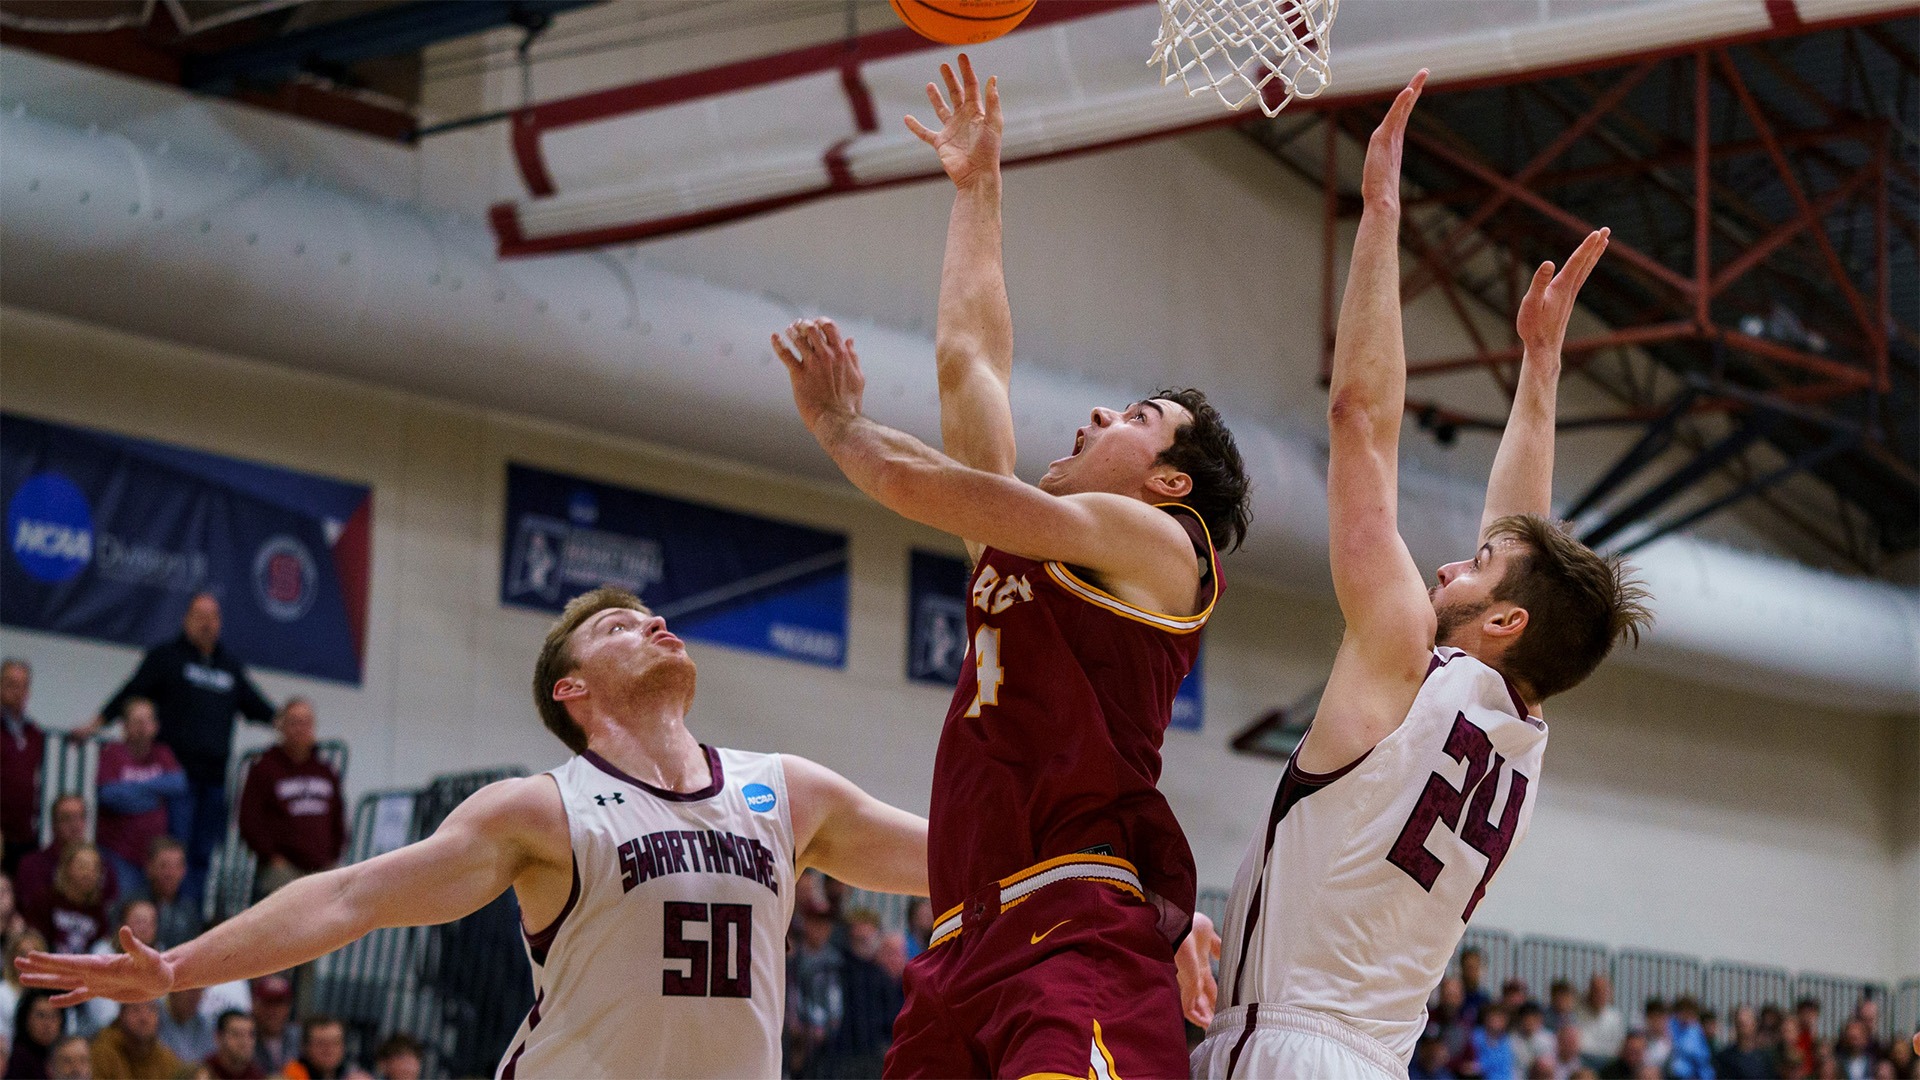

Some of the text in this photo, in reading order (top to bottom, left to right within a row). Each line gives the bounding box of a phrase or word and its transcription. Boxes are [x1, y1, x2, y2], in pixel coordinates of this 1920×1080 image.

[14, 518, 93, 560] NCAA
[747, 793, 775, 805] NCAA
[1385, 710, 1529, 925] 24
[617, 829, 779, 898] SWARTHMORE
[662, 901, 753, 999] 50
